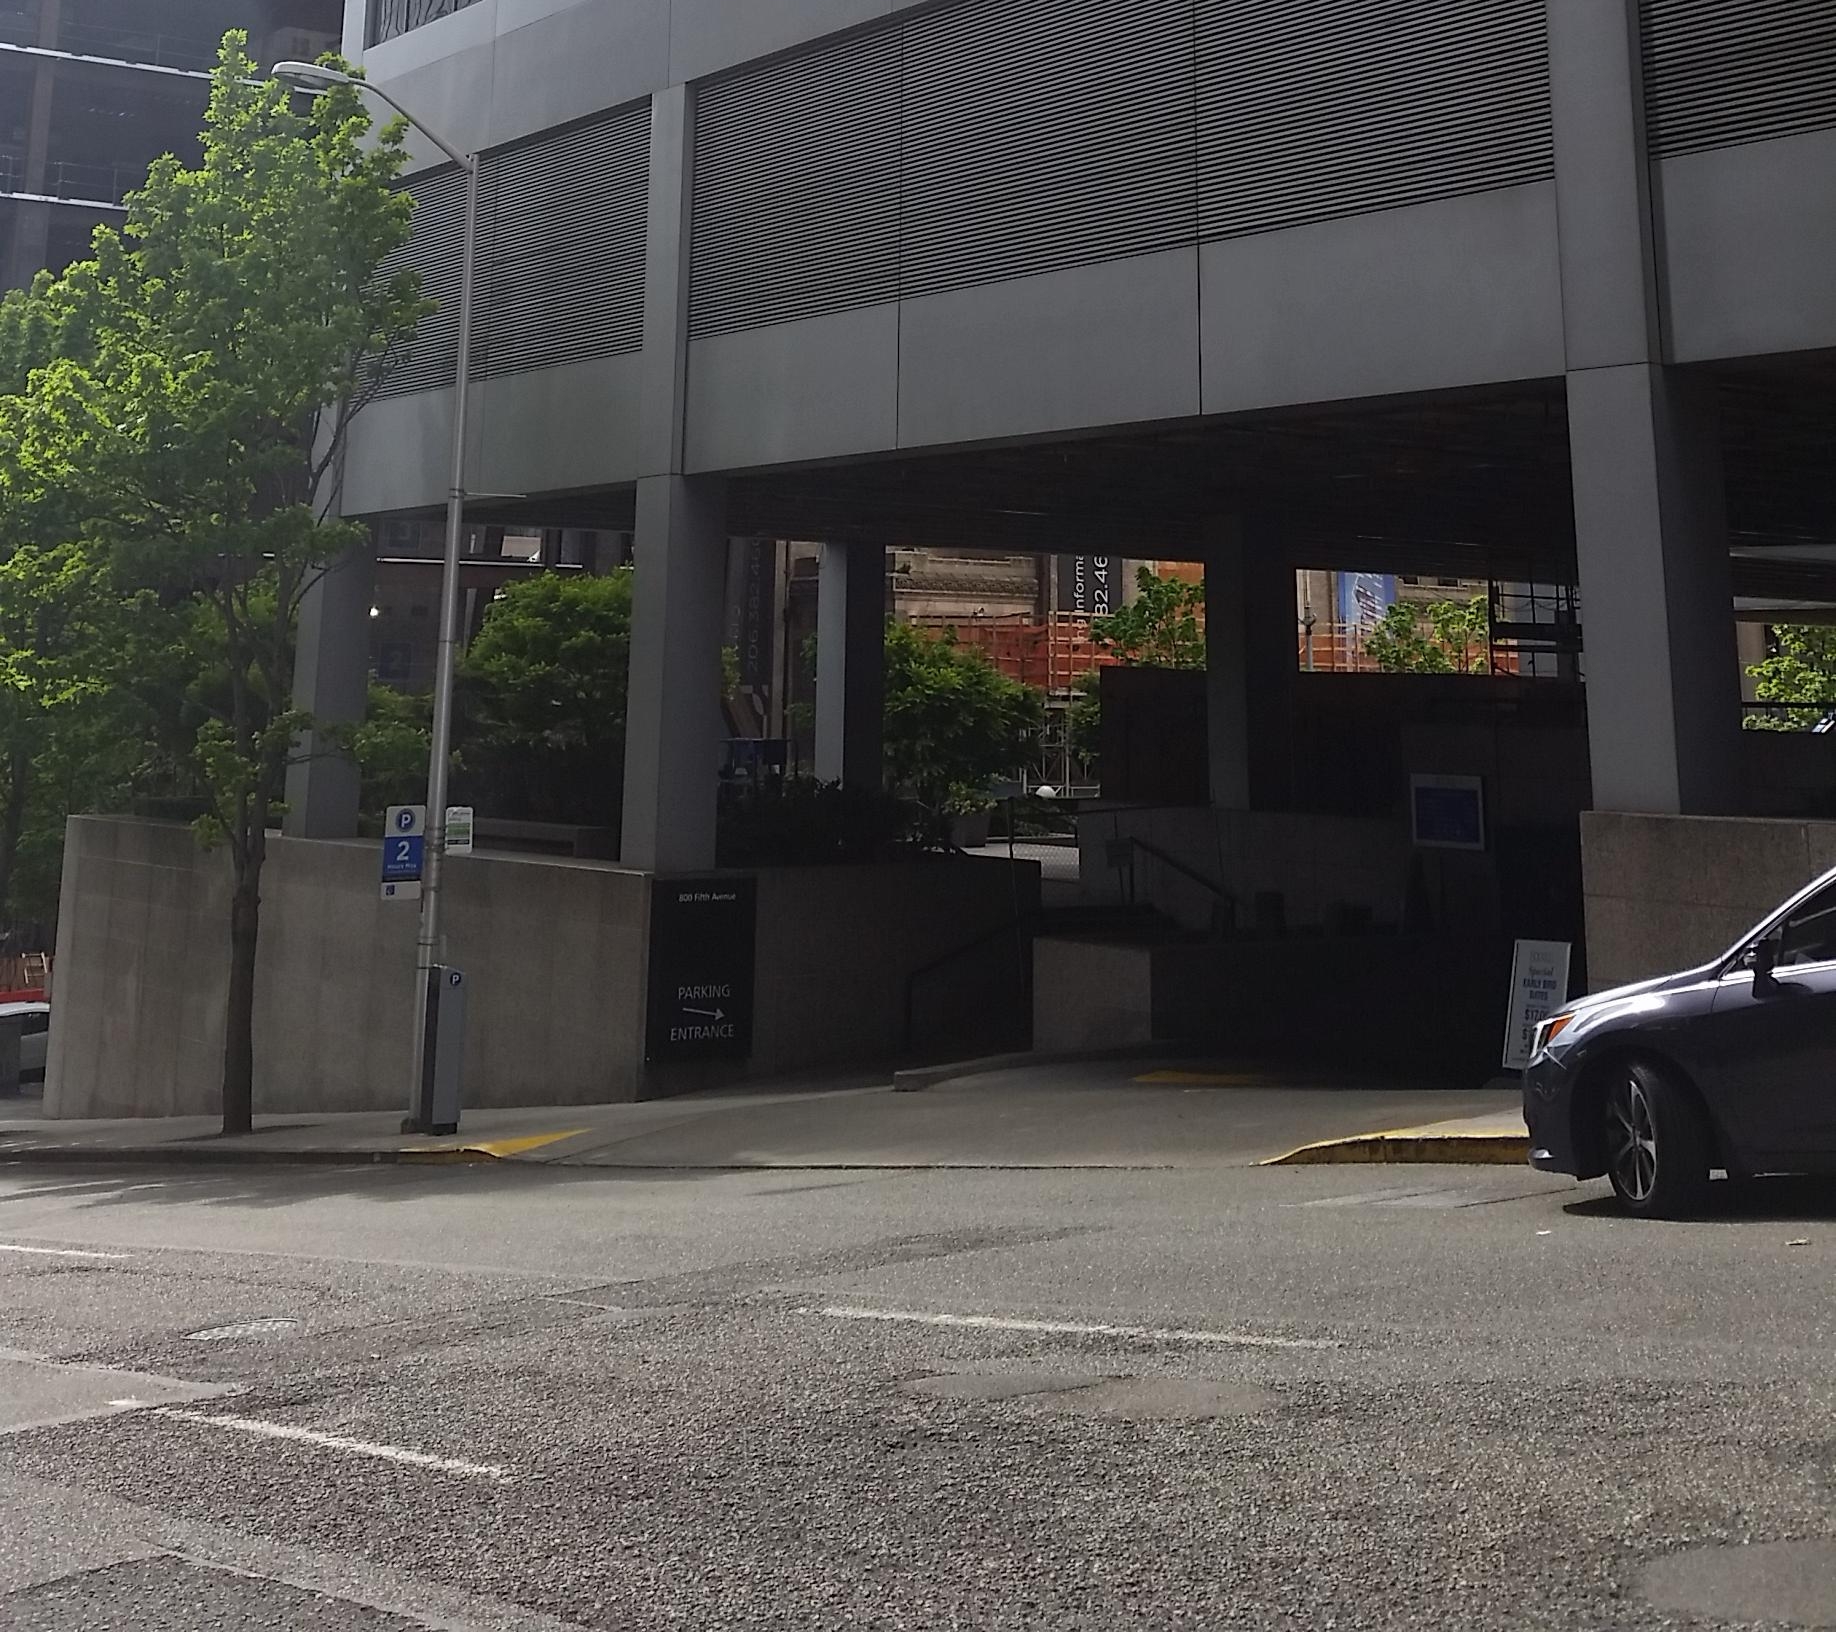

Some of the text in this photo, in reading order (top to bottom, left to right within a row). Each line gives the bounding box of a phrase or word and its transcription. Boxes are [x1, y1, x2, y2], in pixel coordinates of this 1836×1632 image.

[401, 813, 412, 828] P
[396, 840, 410, 862] 2
[678, 892, 737, 903] 800 Fifth Avenue
[452, 974, 460, 985] P
[678, 984, 731, 1001] PARKING
[670, 1023, 735, 1042] ENTRANCE
